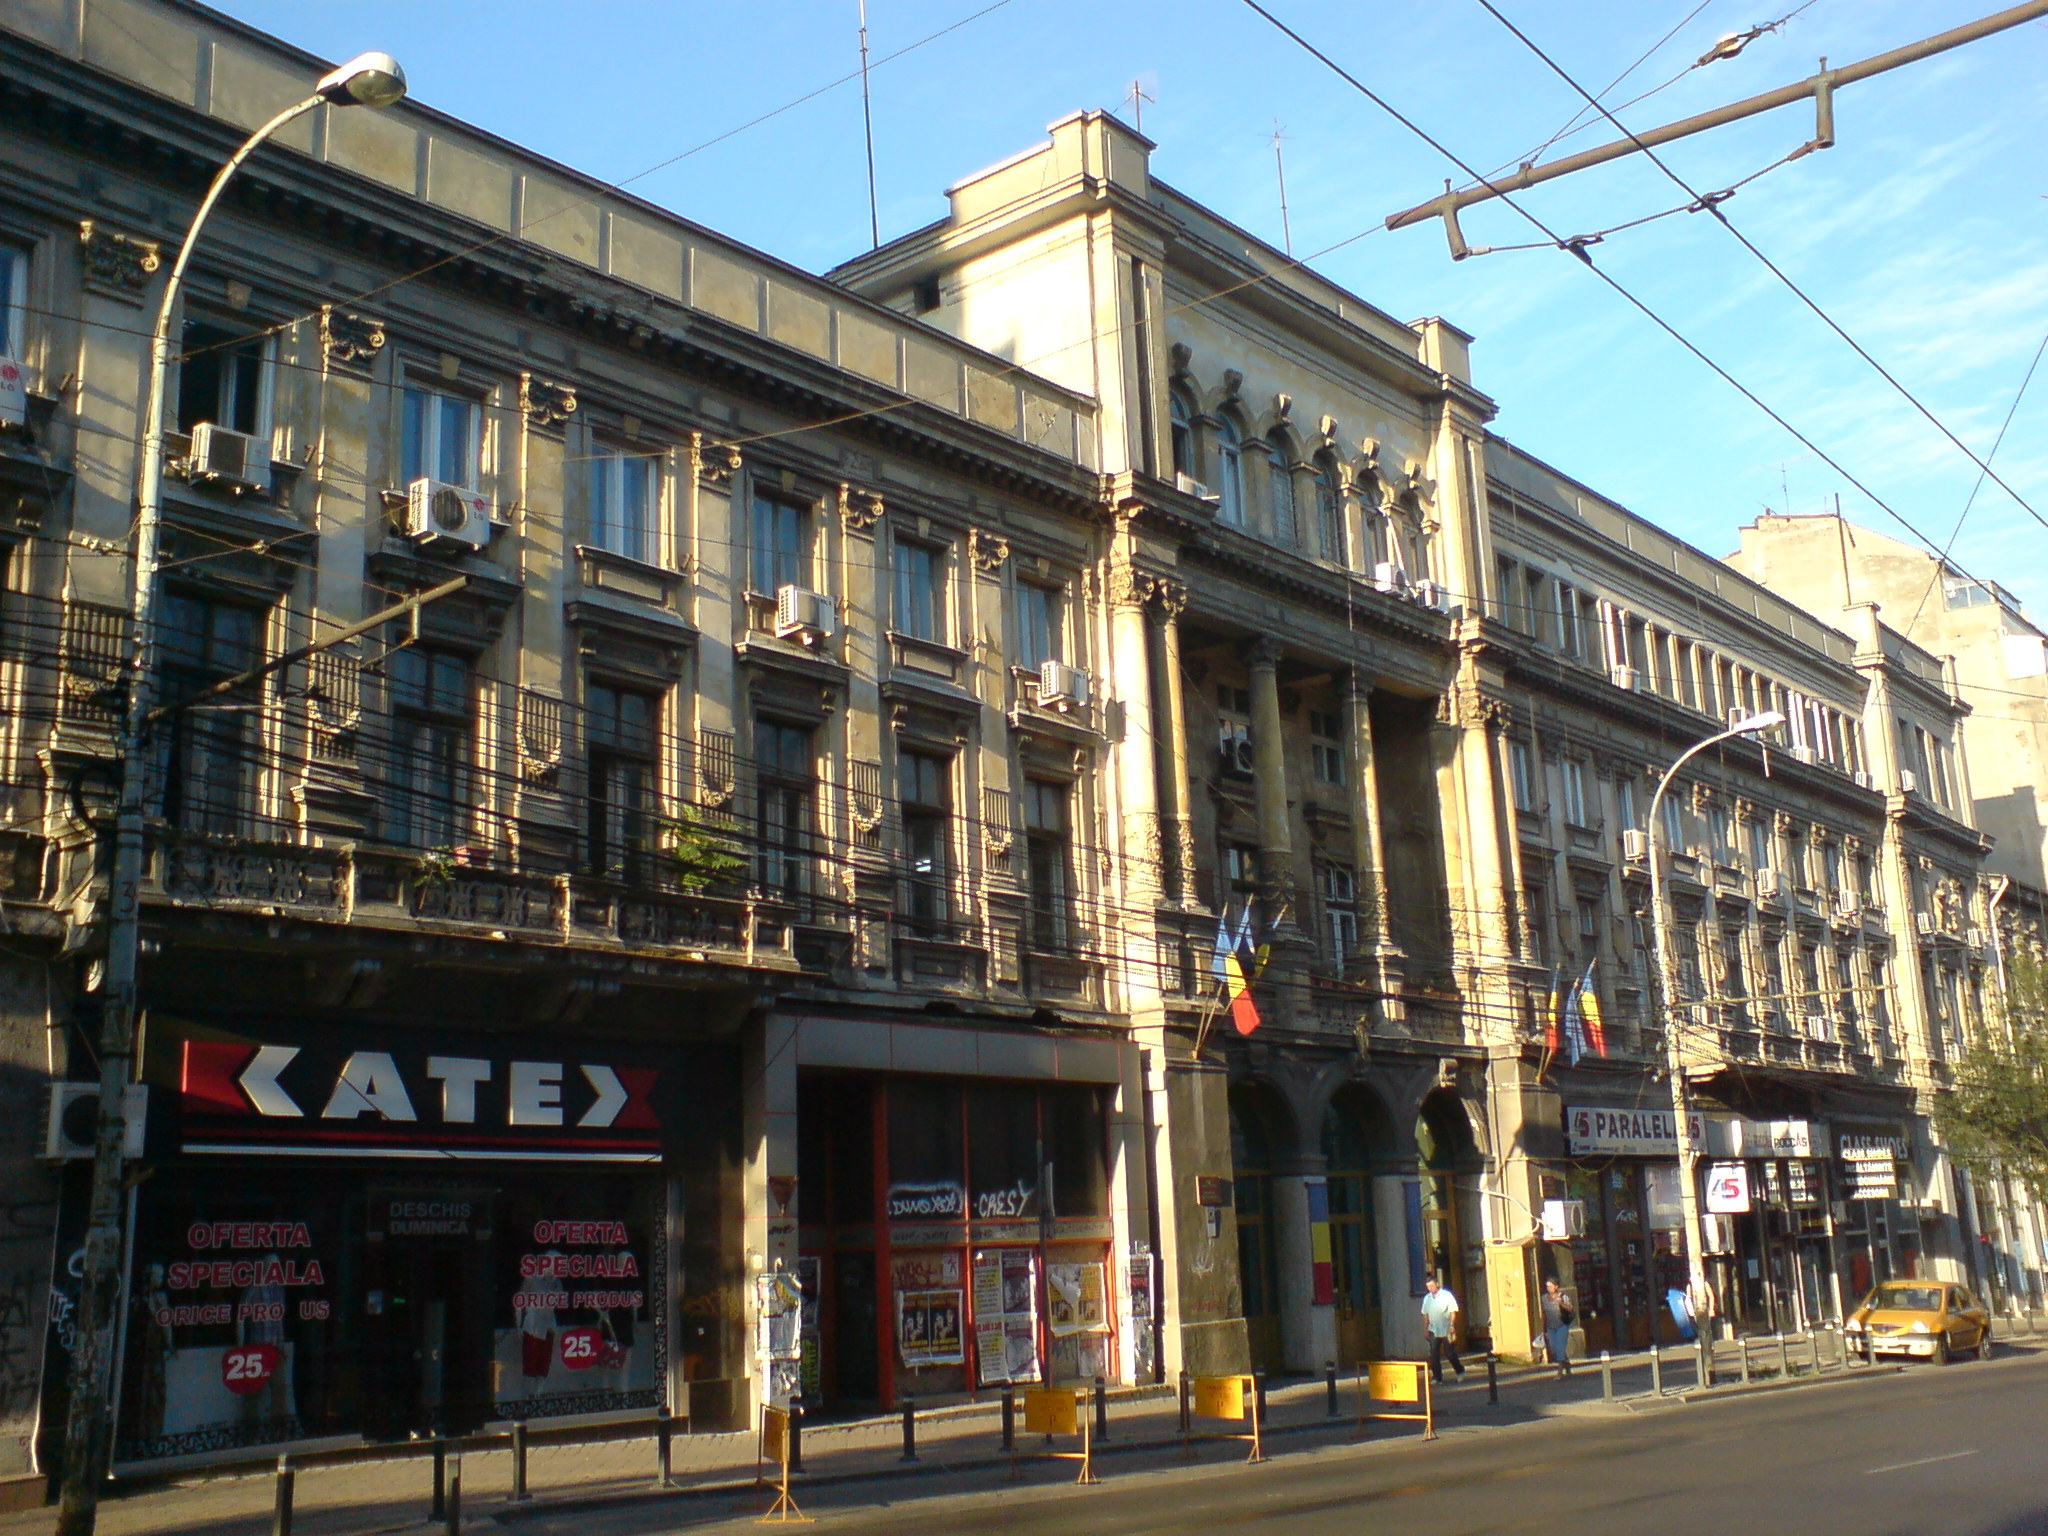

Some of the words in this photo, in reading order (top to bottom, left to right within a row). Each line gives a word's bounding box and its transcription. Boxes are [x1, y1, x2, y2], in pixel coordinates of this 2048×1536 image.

[1596, 1112, 1677, 1139] PARALEL
[390, 1202, 472, 1218] DESCHIS
[187, 1222, 311, 1249] OFERTA
[389, 1220, 469, 1235] DUMINICA
[534, 1220, 628, 1244] OFERTA
[168, 1260, 325, 1289] SPECIALA
[520, 1254, 639, 1278] SPECIALA
[513, 1291, 569, 1309] ORICE
[573, 1290, 644, 1308] PRODUS
[156, 1304, 231, 1327] ORICE
[238, 1301, 330, 1323] PROUS
[564, 1336, 591, 1358] 25
[226, 1353, 263, 1380] 25
